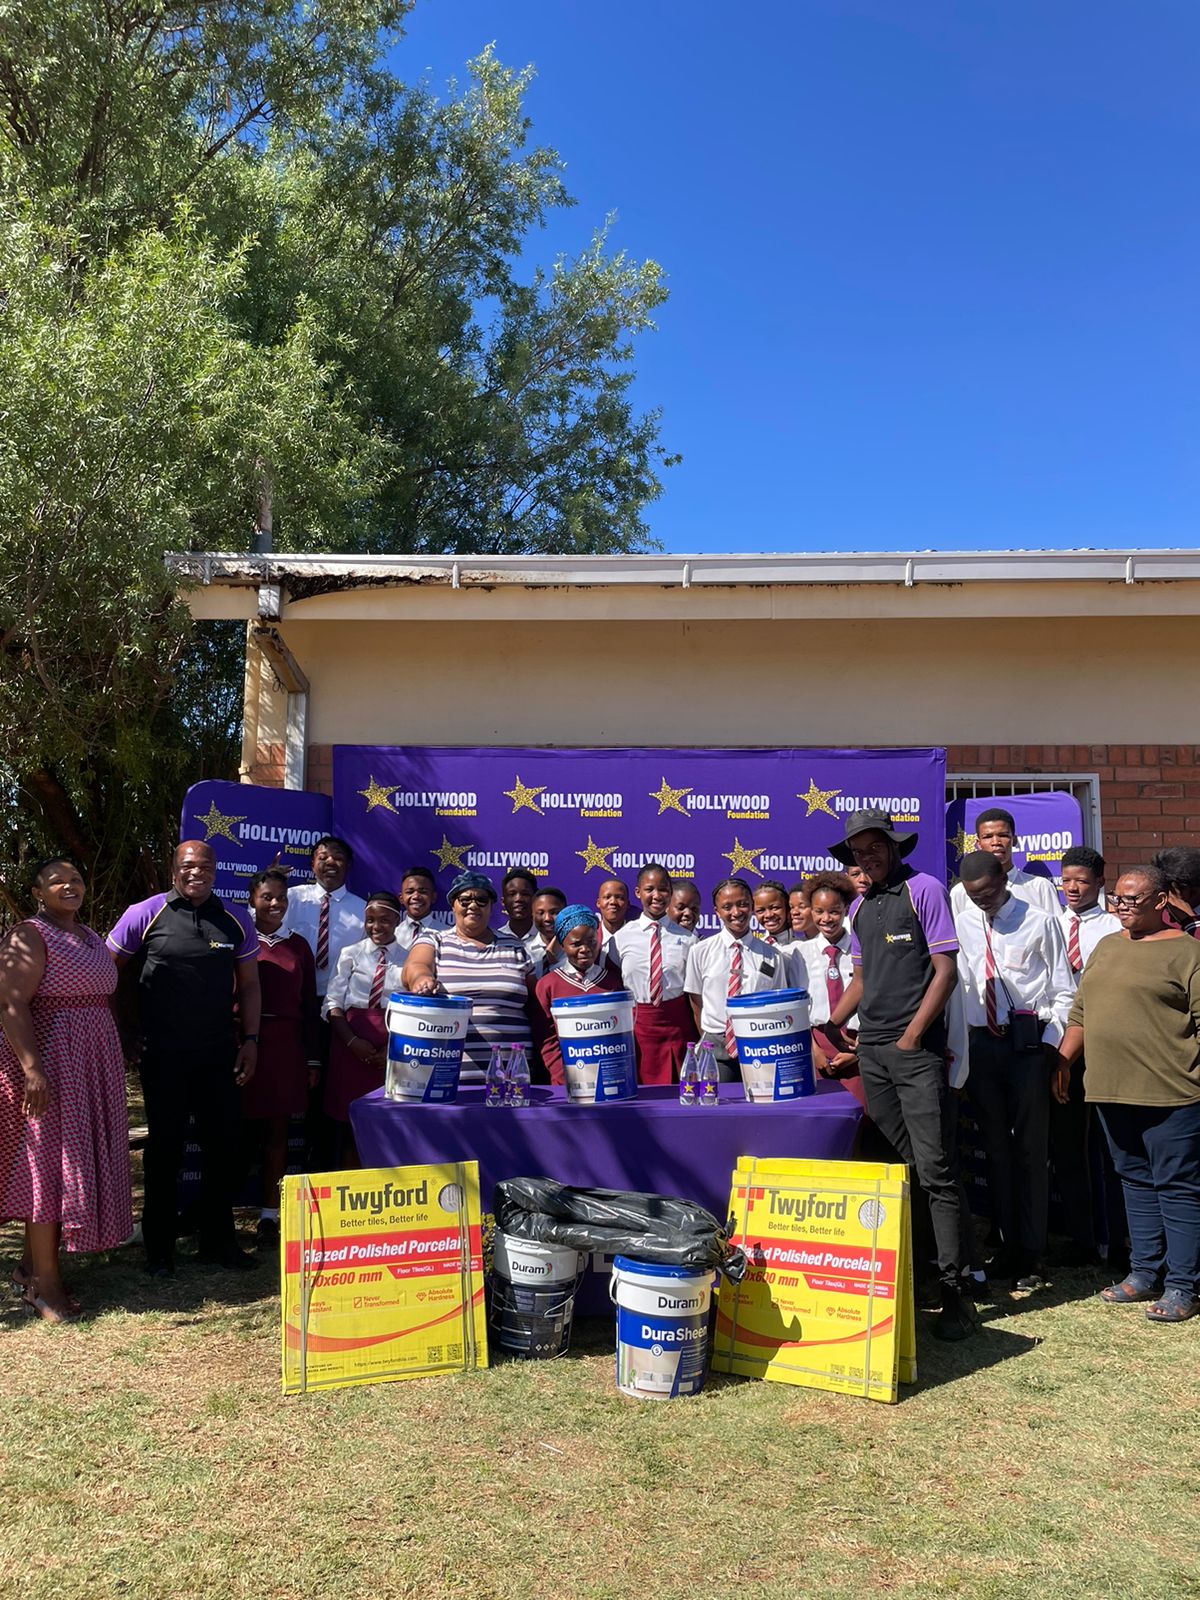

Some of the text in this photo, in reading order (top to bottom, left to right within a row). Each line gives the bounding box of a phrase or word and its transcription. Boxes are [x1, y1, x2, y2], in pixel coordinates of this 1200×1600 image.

[395, 792, 477, 807] HOLLYWOOD
[540, 793, 623, 809] HOLLYWOOD
[687, 794, 770, 810] HOLLYWOOD
[835, 796, 920, 813] HOLLYWOOD
[435, 808, 477, 817] Foundation
[580, 809, 623, 818] Foundation
[727, 810, 770, 819] Foundation
[890, 813, 920, 822] ndation
[467, 852, 549, 867] HOLLYWOOD
[612, 853, 695, 869] HOLLYWOOD
[1026, 850, 1066, 862] Foundati
[668, 869, 695, 878] dation
[418, 1021, 453, 1033] Duram
[575, 1020, 611, 1032] Duram
[750, 1020, 786, 1031] Duram
[403, 1043, 461, 1058] DuraSheen
[567, 1042, 627, 1058] DuraSheen
[743, 1042, 804, 1057] DuraSheen
[336, 1180, 428, 1215] Twyford
[768, 1190, 848, 1222] Twyford
[340, 1212, 428, 1228] Better tiles, Better life
[768, 1221, 790, 1231] Better
[809, 1225, 832, 1235] Better
[833, 1228, 845, 1236] life
[349, 1240, 407, 1260] Polished
[772, 1247, 824, 1266] Polished
[512, 1261, 545, 1274] Duram
[358, 1271, 383, 1283] mm
[778, 1276, 799, 1287] mm
[658, 1296, 699, 1309] Duram
